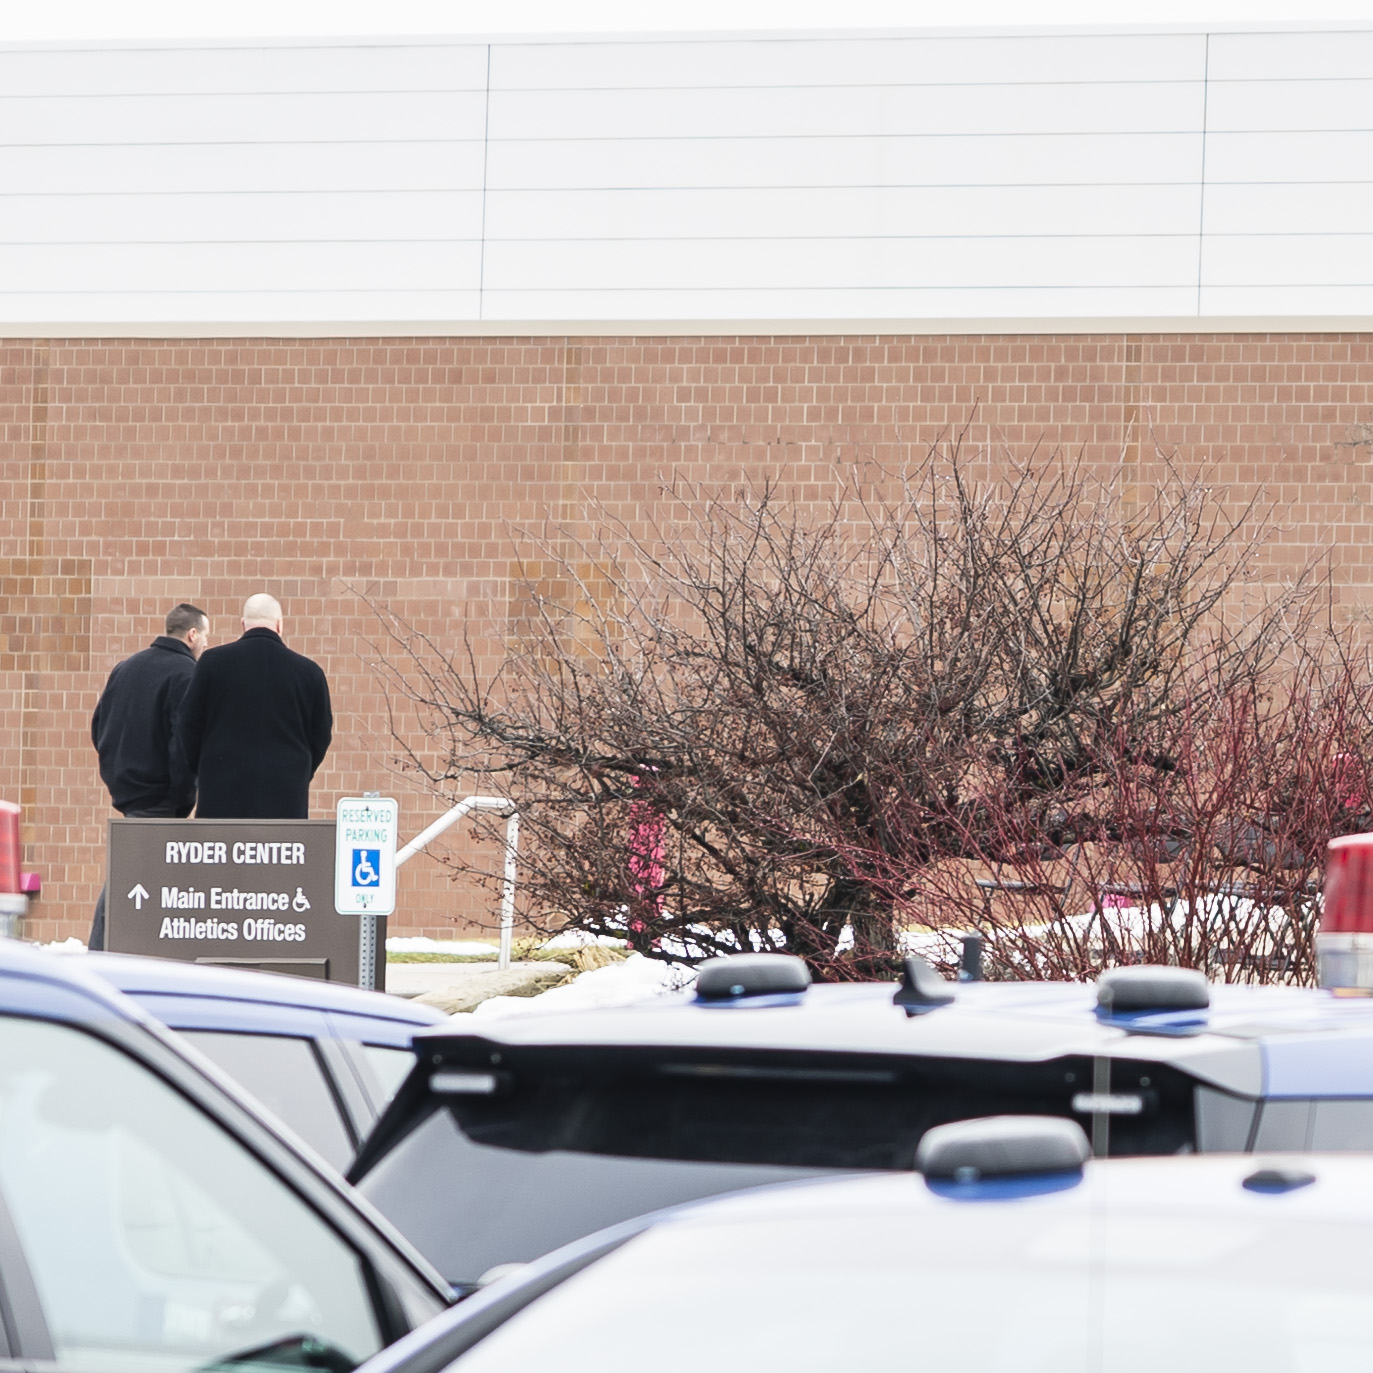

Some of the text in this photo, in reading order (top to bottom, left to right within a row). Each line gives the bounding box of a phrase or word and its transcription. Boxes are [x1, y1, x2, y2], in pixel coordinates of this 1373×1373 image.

[342, 809, 392, 823] RESERVED
[346, 829, 388, 843] PARKING
[165, 842, 306, 864] RYDER CENTER
[161, 887, 289, 911] Main Entrance
[159, 917, 306, 942] Athletics Offices
